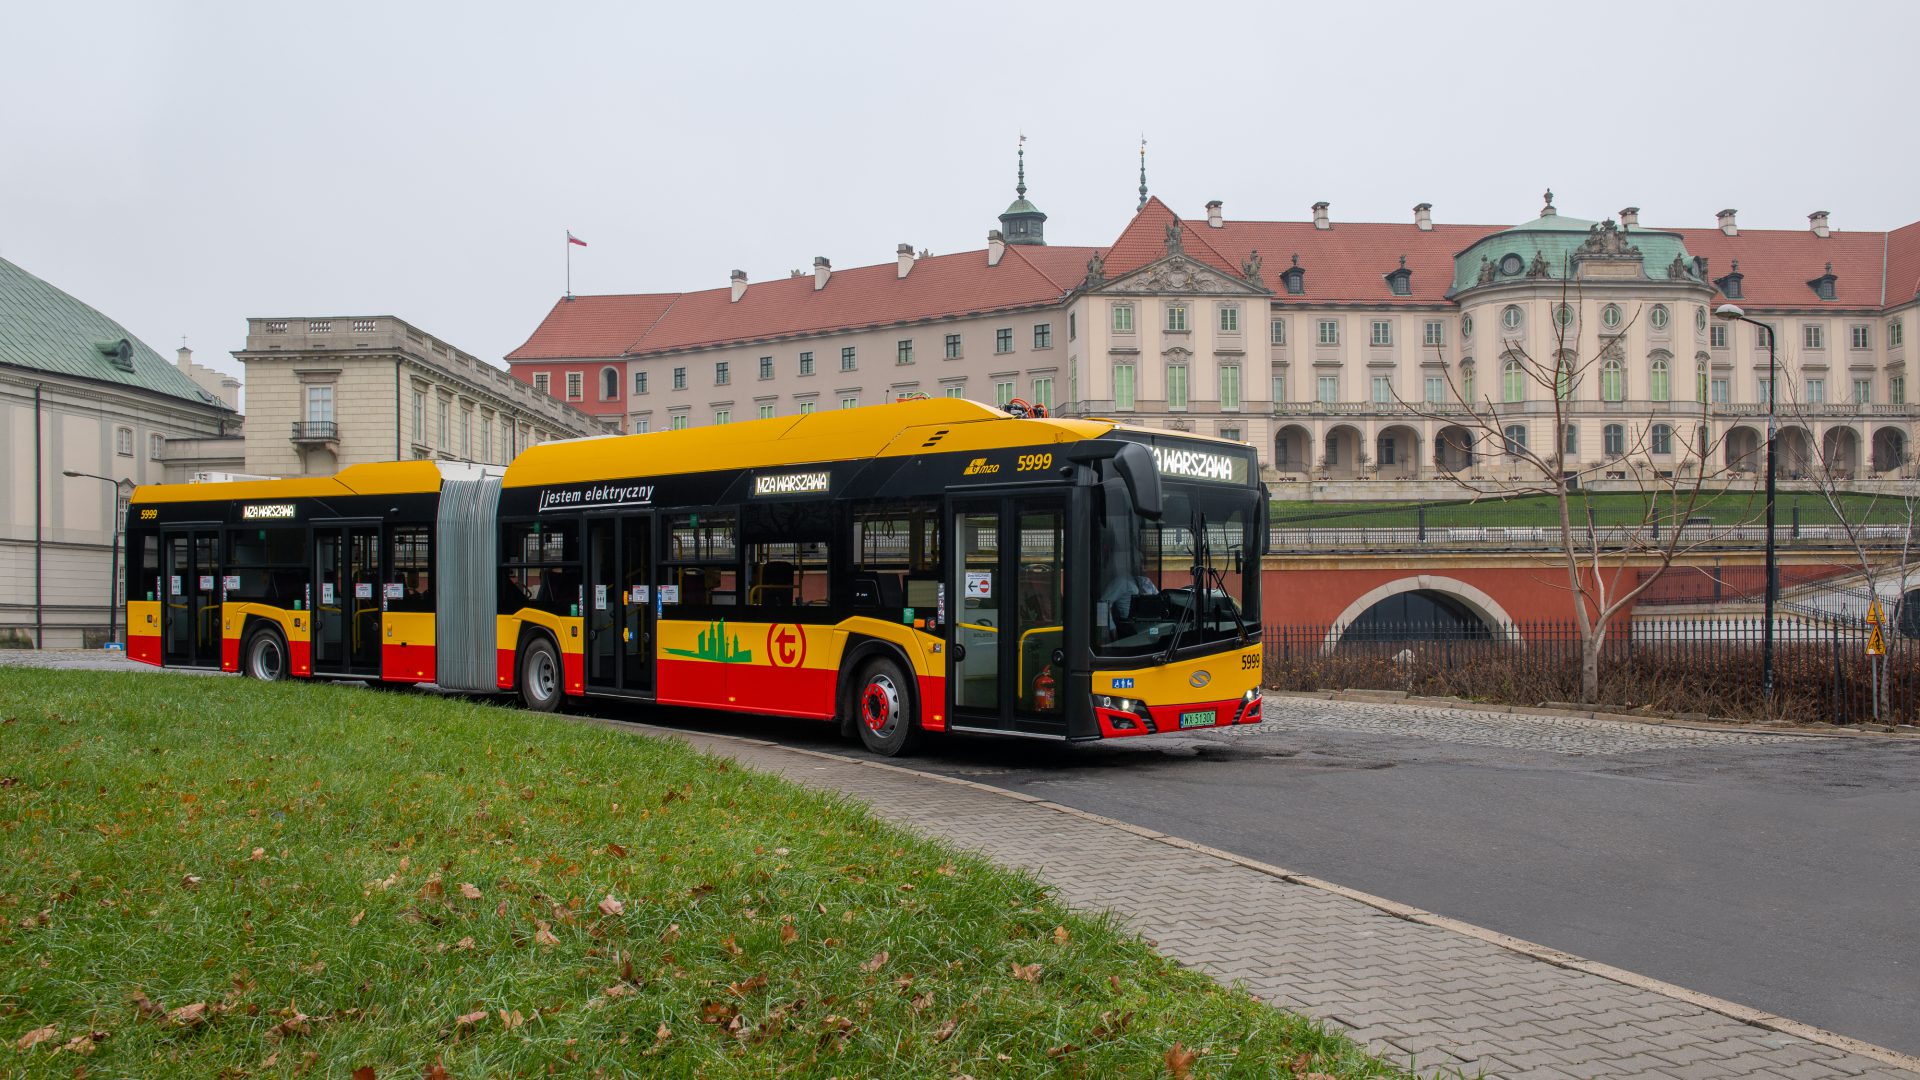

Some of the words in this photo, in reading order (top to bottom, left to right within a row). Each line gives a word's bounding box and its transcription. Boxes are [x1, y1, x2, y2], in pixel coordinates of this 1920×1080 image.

[1017, 453, 1052, 471] 5999
[1163, 448, 1232, 480] WARSZAWA
[757, 476, 776, 493] MZA
[777, 473, 827, 491] WARSZAWA
[544, 489, 581, 507] jestem
[585, 485, 655, 502] elektryczny
[140, 509, 157, 519] 5999
[245, 506, 258, 518] MZA
[259, 505, 294, 517] WARSZAWA
[1241, 653, 1260, 670] 5999
